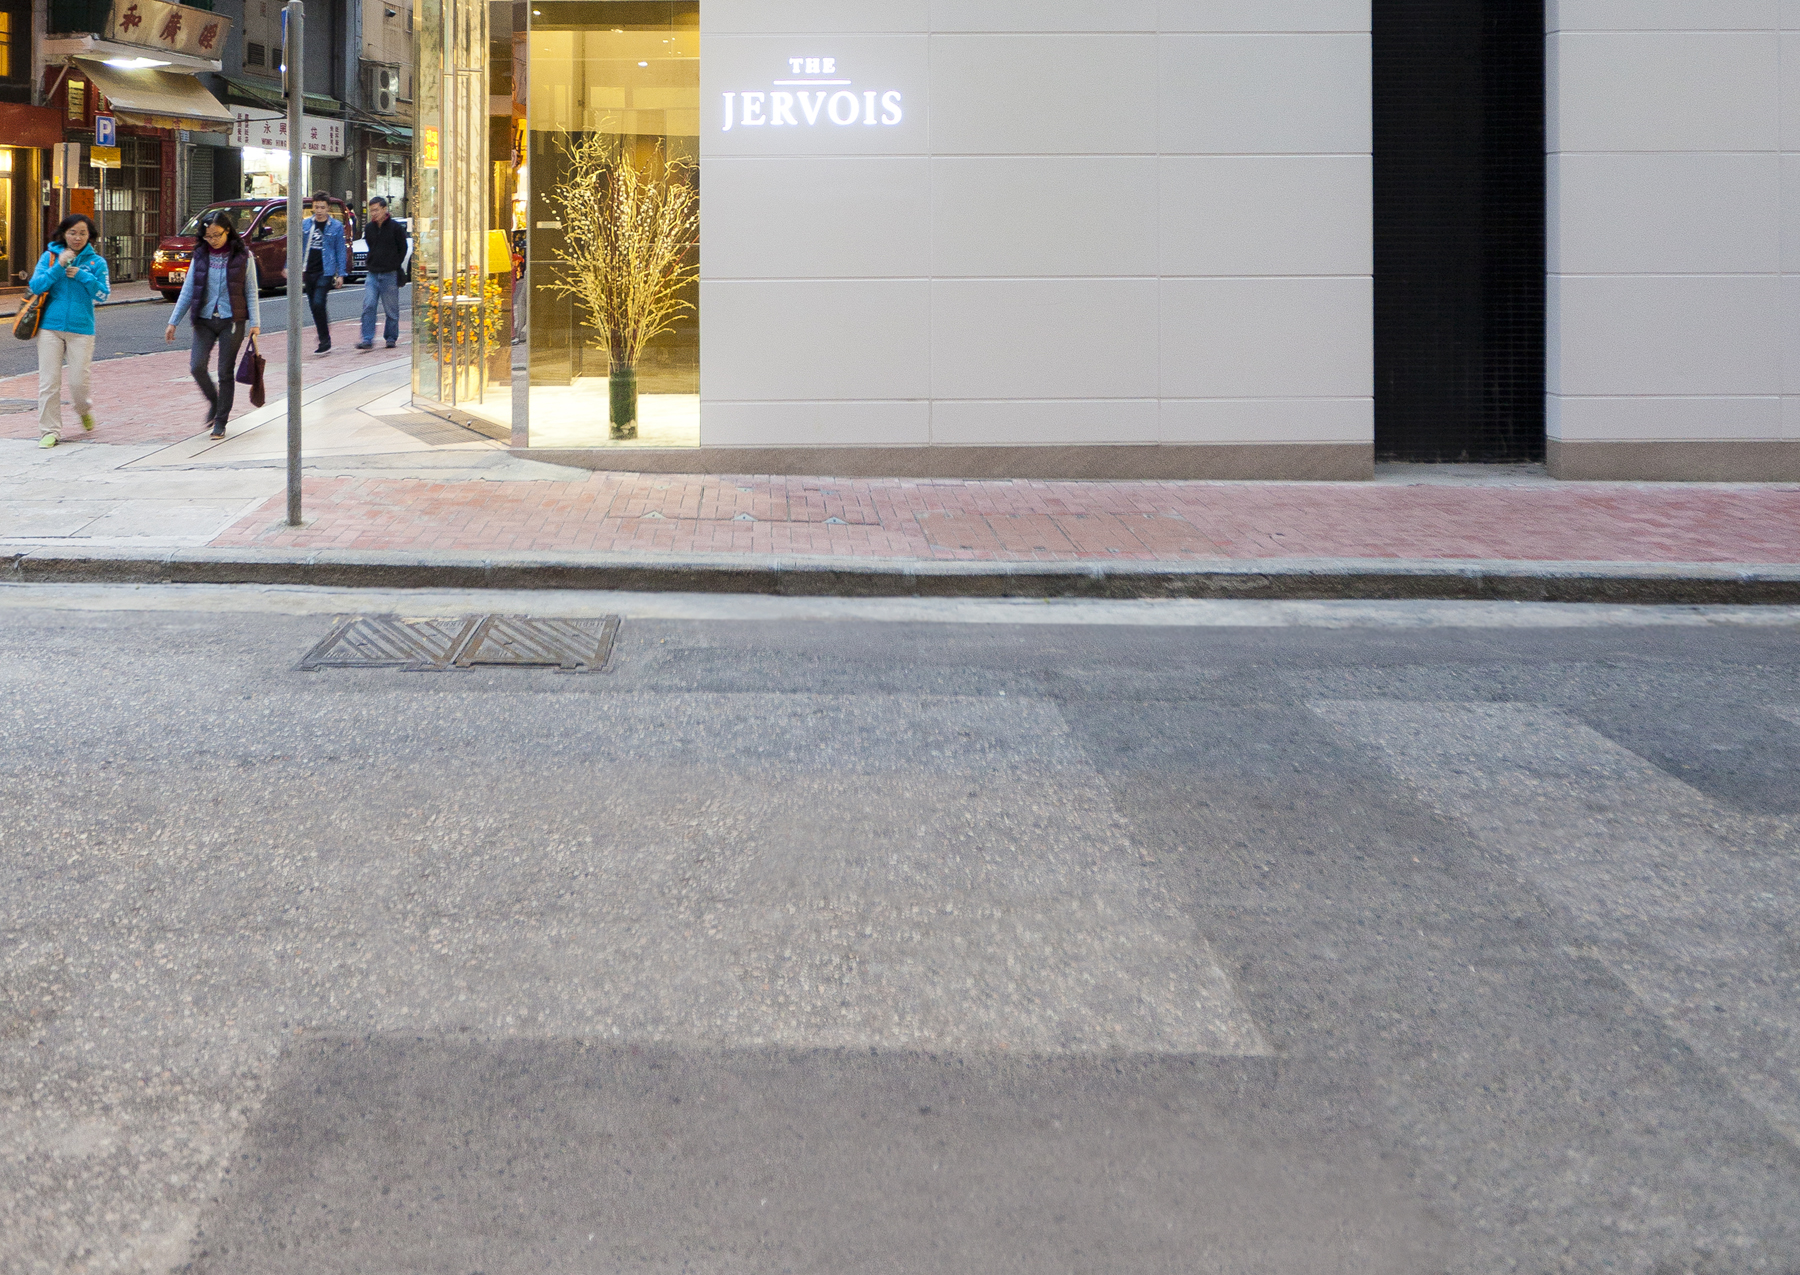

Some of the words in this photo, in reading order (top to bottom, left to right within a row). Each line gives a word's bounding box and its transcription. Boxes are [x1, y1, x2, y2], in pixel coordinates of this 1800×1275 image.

[789, 57, 836, 74] THE
[721, 90, 903, 131] JERVOIS
[100, 118, 112, 142] P
